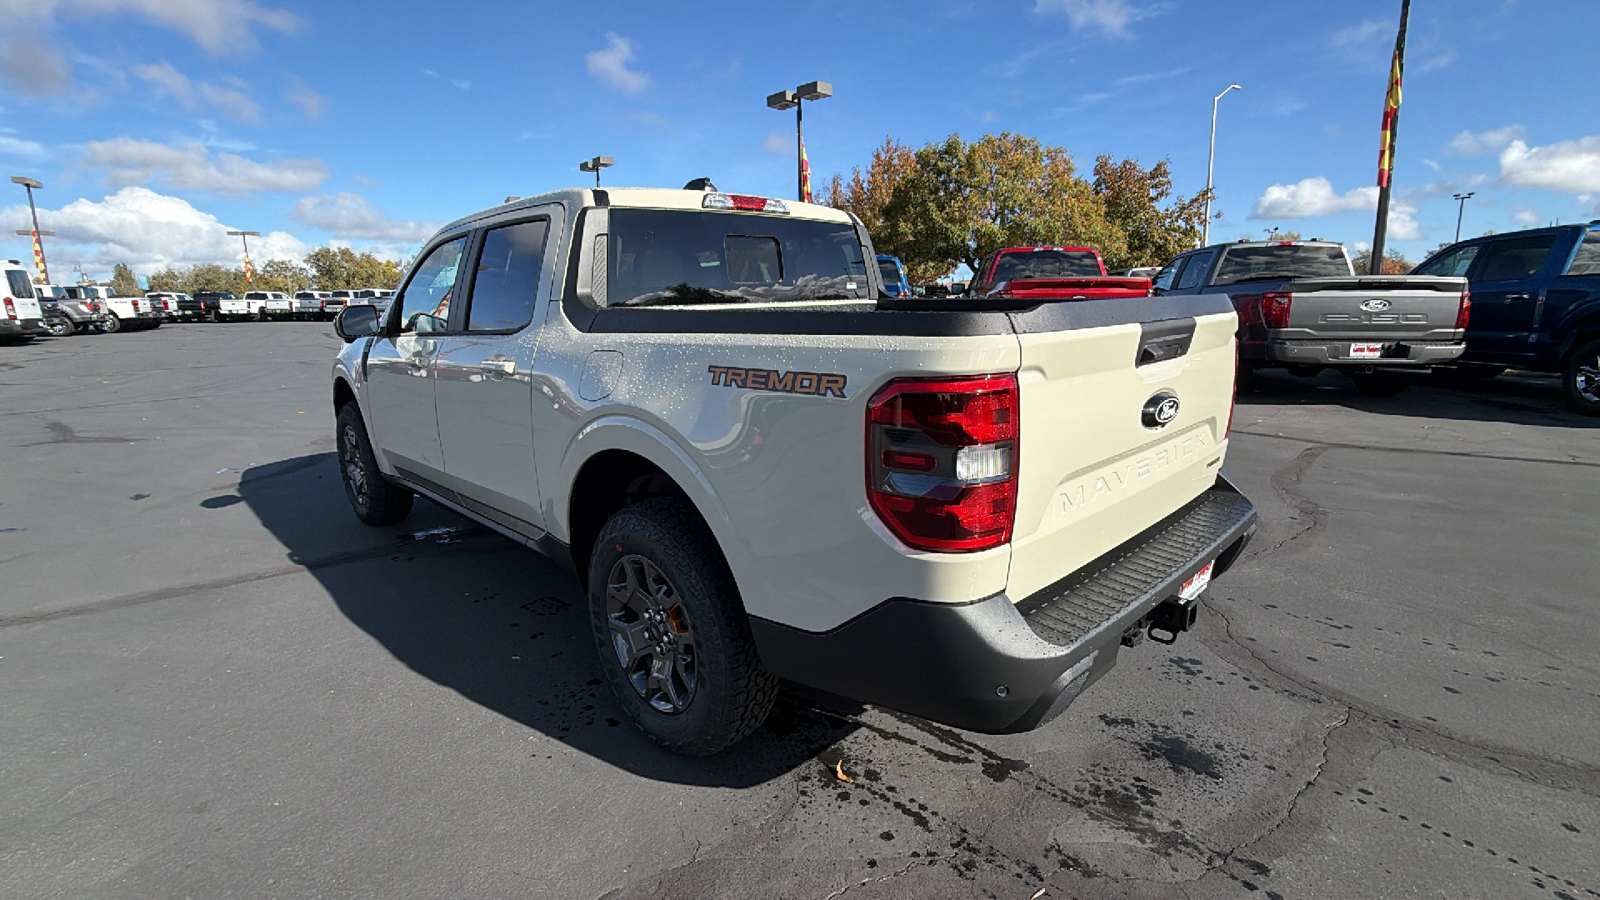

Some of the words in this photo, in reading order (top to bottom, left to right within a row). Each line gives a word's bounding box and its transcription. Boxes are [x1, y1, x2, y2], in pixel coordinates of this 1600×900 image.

[1318, 313, 1428, 324] F-150
[708, 365, 847, 398] TREMOR
[1060, 432, 1206, 515] MAVERICK
